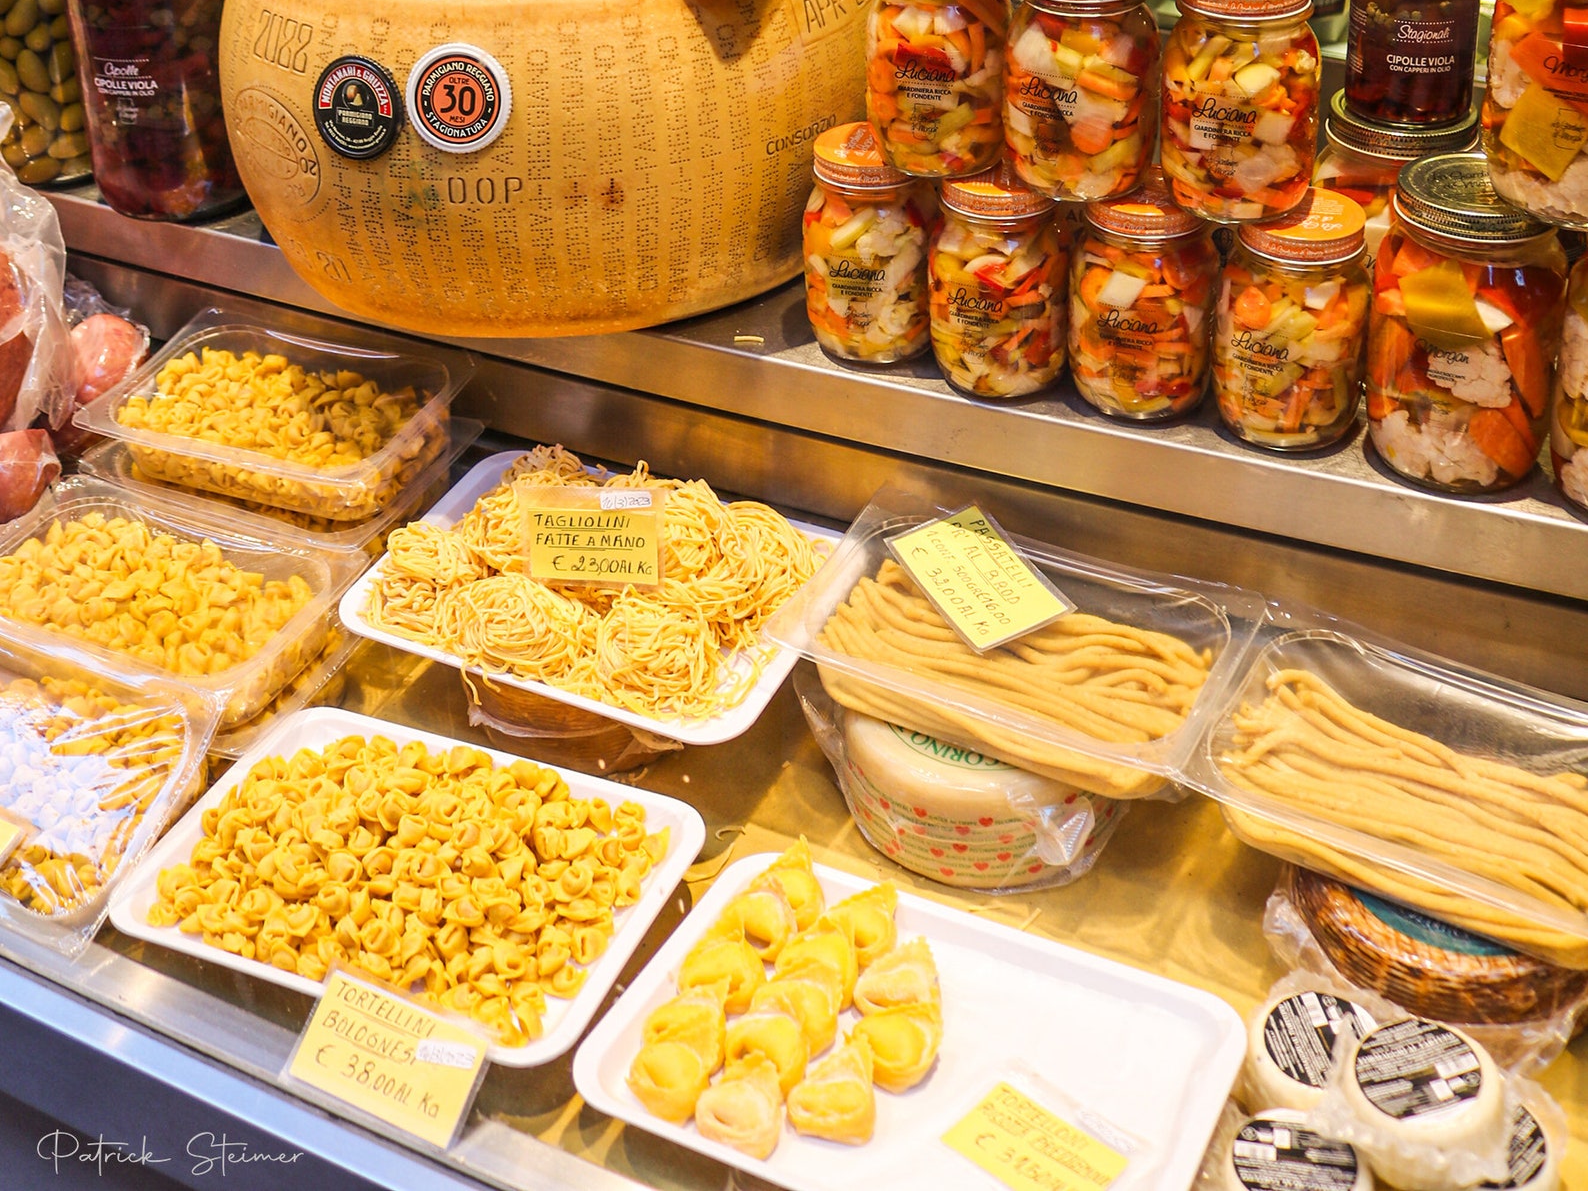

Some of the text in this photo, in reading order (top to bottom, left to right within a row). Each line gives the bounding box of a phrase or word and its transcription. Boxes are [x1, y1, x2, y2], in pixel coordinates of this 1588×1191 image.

[1397, 24, 1450, 43] Stagionali
[895, 59, 956, 83] Luciana
[1386, 54, 1455, 67] CIPOLLE VIOLA
[1404, 66, 1430, 74] CAPPERI
[127, 80, 158, 90] VIOLA
[321, 66, 389, 106] MONTANARI & GRUZZA
[423, 62, 495, 102] PARMIGIANO REGGIANO
[449, 76, 470, 86] OLTRE
[1020, 76, 1079, 105] Luciana
[440, 84, 476, 116] 30
[1192, 97, 1257, 125] Luciana
[425, 111, 488, 137] STAGIONATURA
[449, 115, 466, 124] MESI
[766, 113, 837, 155] CONSORZIO
[947, 288, 1003, 313] Luciana
[1097, 309, 1158, 335] Luciana
[1231, 331, 1289, 361] Luciana
[534, 513, 631, 528] TAGLIOLINI
[536, 533, 645, 548] FATTE A MANO
[552, 555, 568, 572] €
[969, 519, 1033, 589] PASSATELLI
[336, 980, 436, 1038] TORTELLINI
[315, 1044, 337, 1069] €
